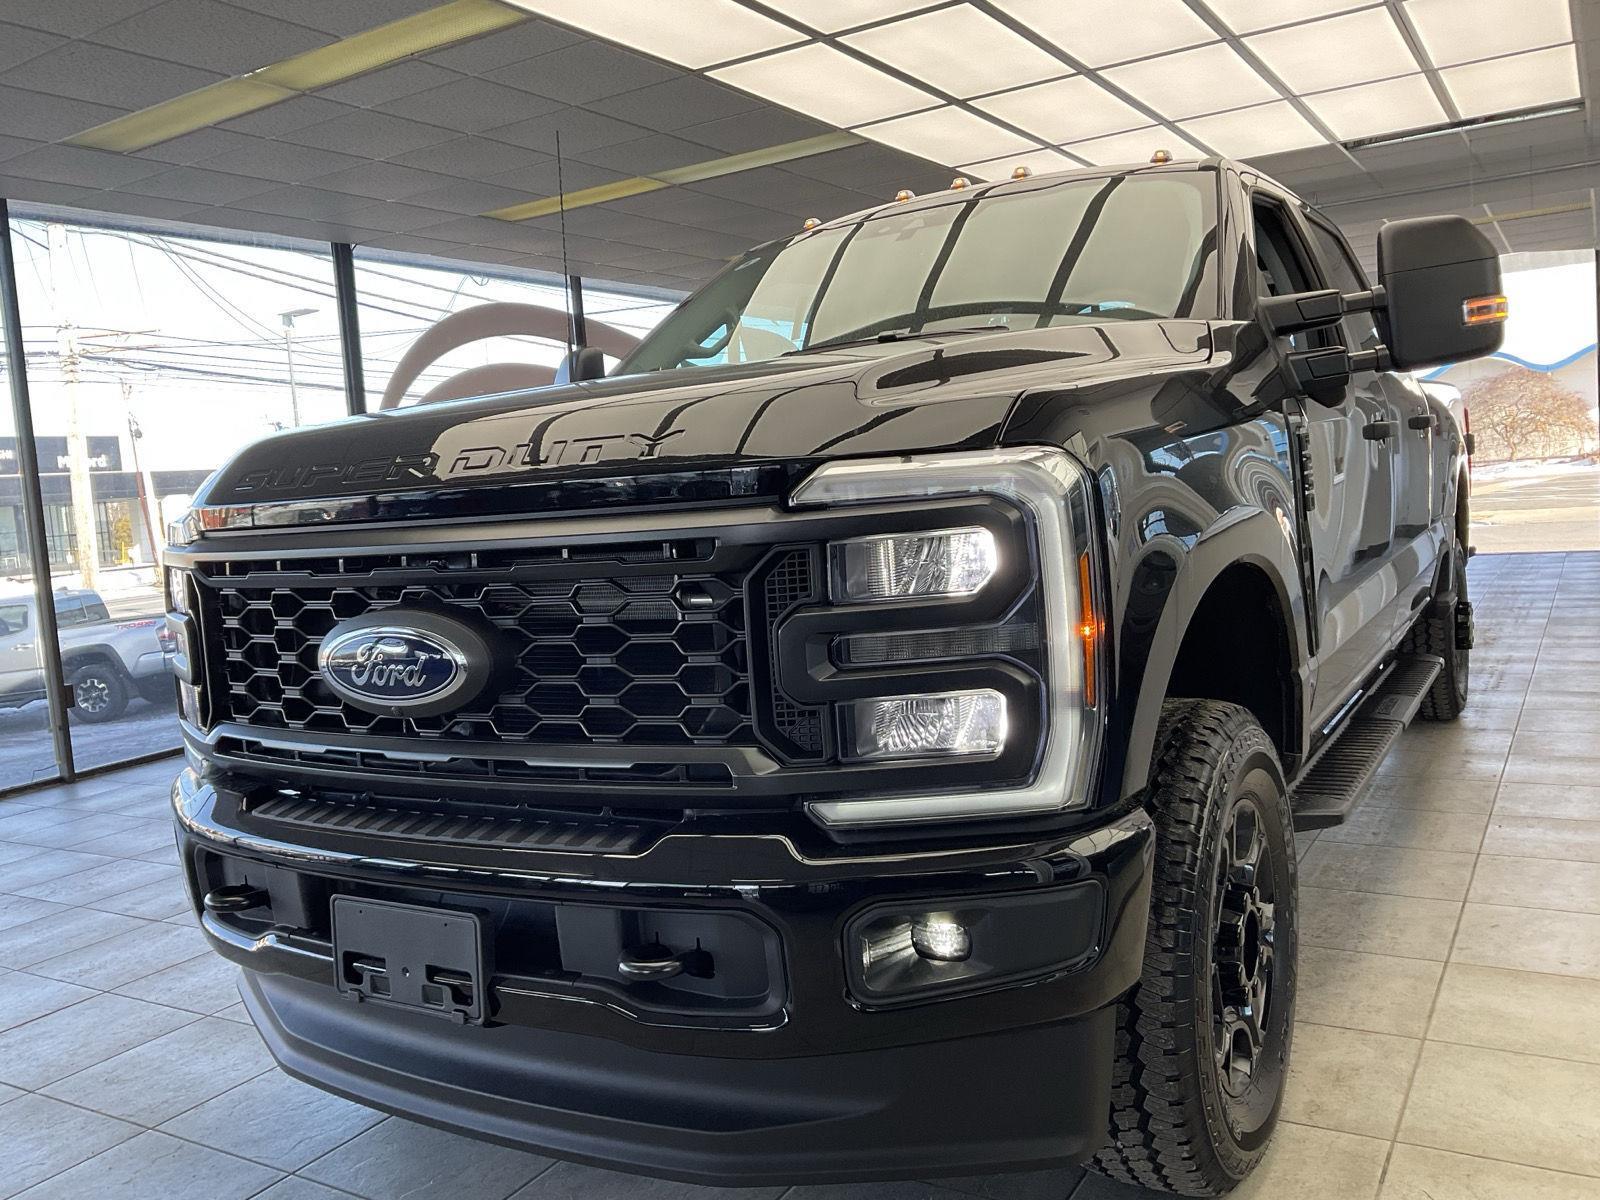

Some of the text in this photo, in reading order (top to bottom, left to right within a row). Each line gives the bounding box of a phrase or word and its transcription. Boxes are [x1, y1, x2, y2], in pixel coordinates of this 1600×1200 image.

[234, 429, 685, 491] SUPER DUTY
[351, 642, 428, 687] Ford
